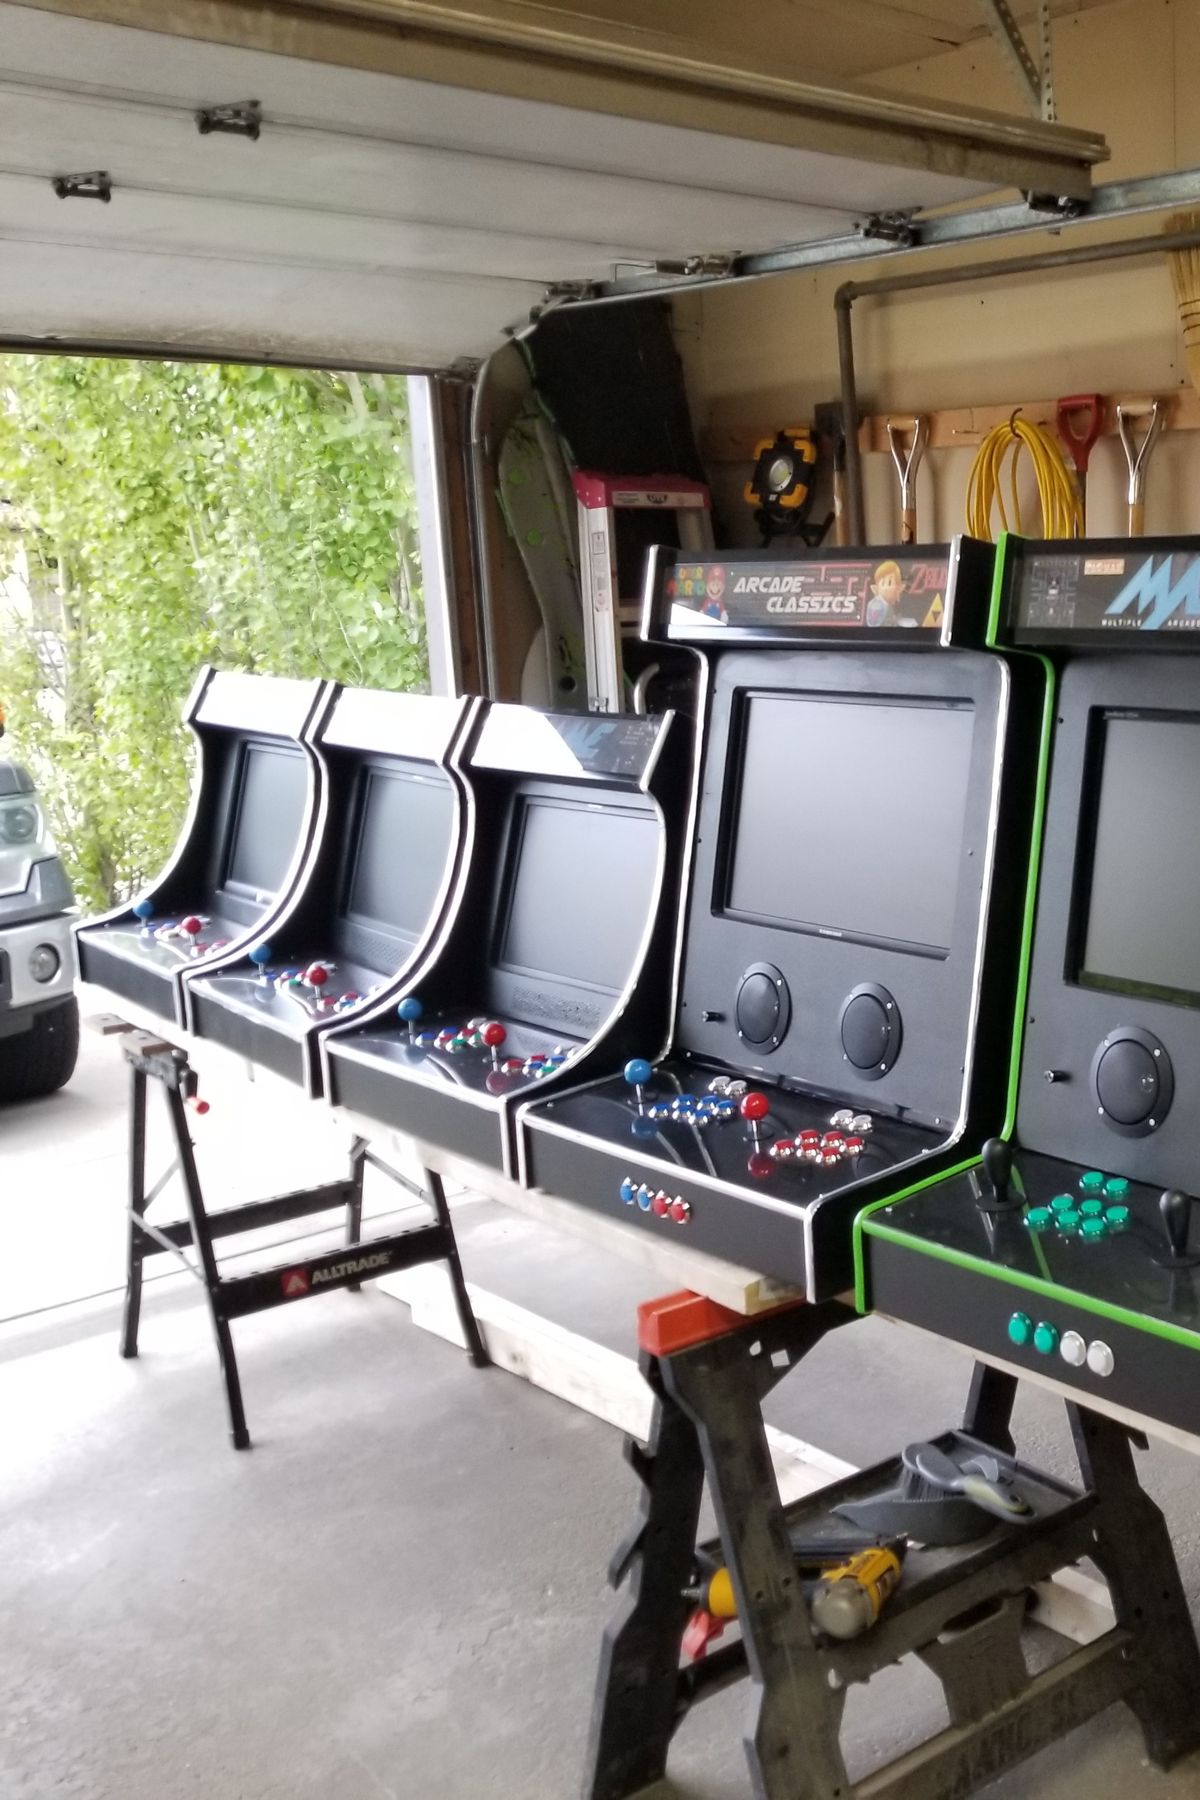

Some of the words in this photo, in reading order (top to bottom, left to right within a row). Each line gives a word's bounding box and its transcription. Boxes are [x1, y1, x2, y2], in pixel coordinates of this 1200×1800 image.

[733, 576, 805, 593] ARCADE
[766, 596, 857, 613] CLASSICS
[1102, 619, 1142, 627] MULTIPLE
[1167, 619, 1200, 628] ARCADE
[312, 1252, 390, 1284] ALLTRADE
